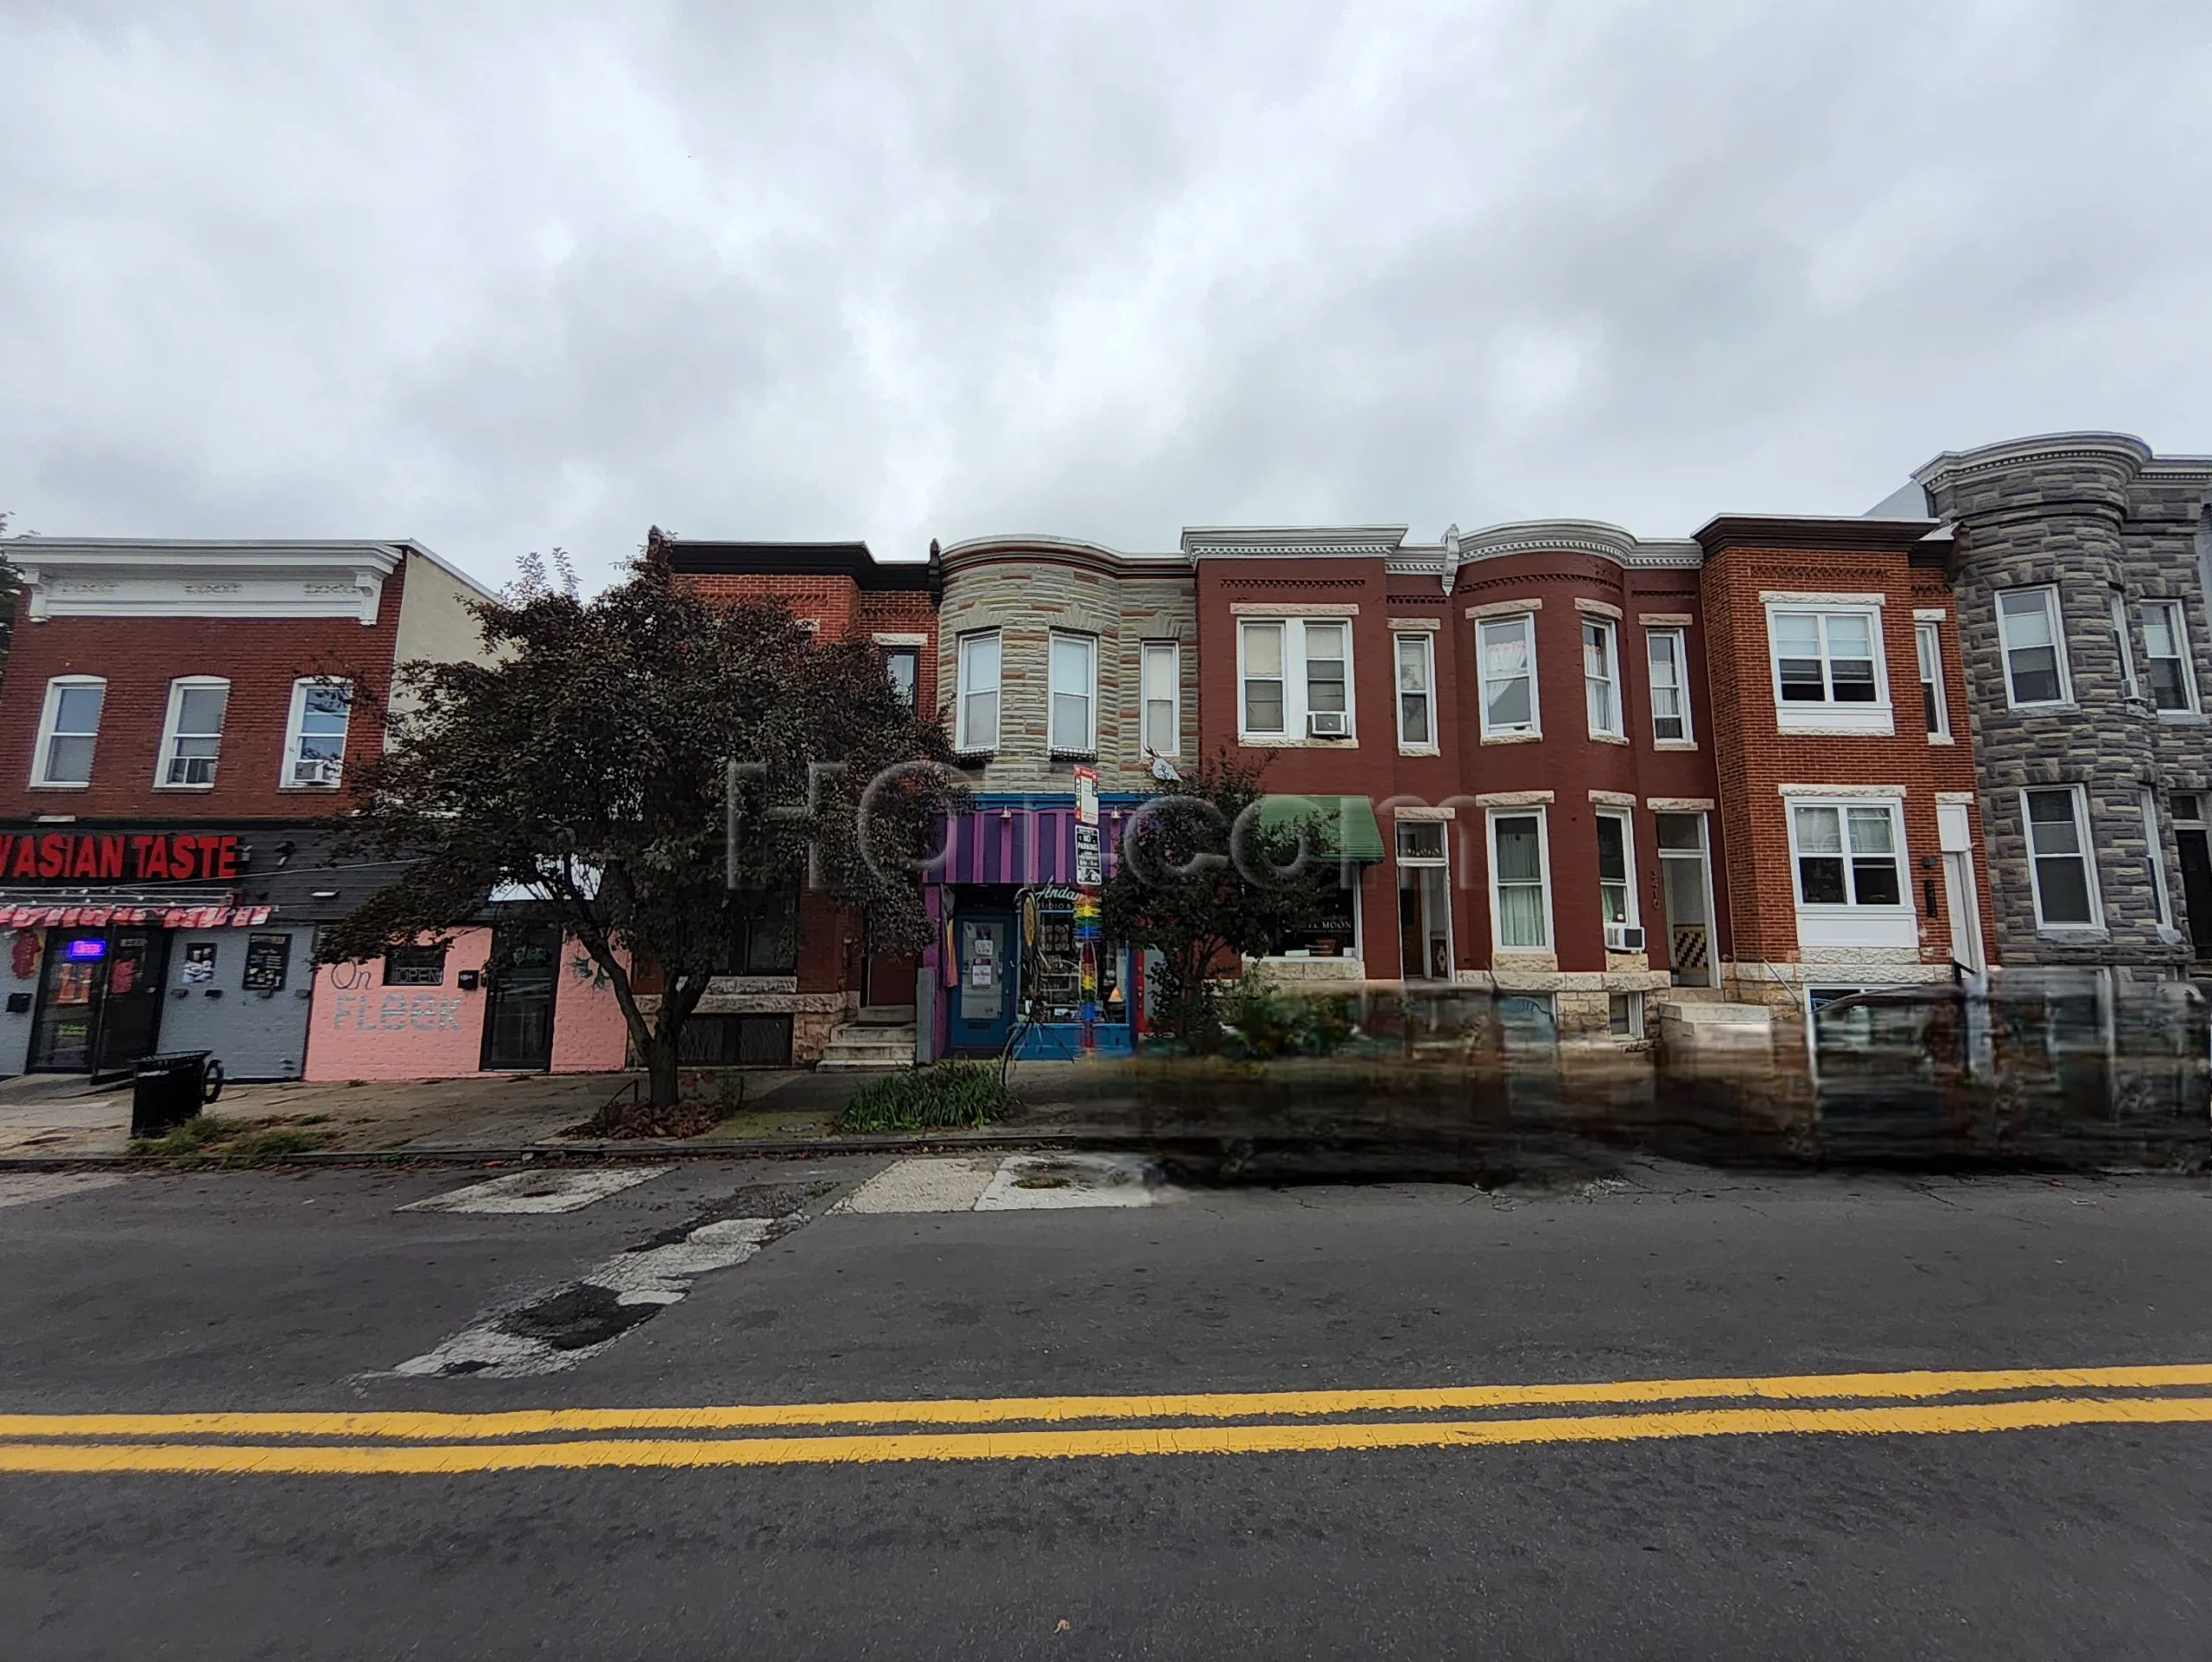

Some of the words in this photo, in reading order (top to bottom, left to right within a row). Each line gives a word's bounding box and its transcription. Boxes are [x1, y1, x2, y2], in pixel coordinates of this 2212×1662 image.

[1083, 834, 1092, 843] NO
[12, 832, 126, 878] ASIAN
[132, 835, 238, 879] TASTE
[1322, 920, 1351, 929] MOON
[331, 959, 373, 990] On
[398, 968, 441, 984] OPEN
